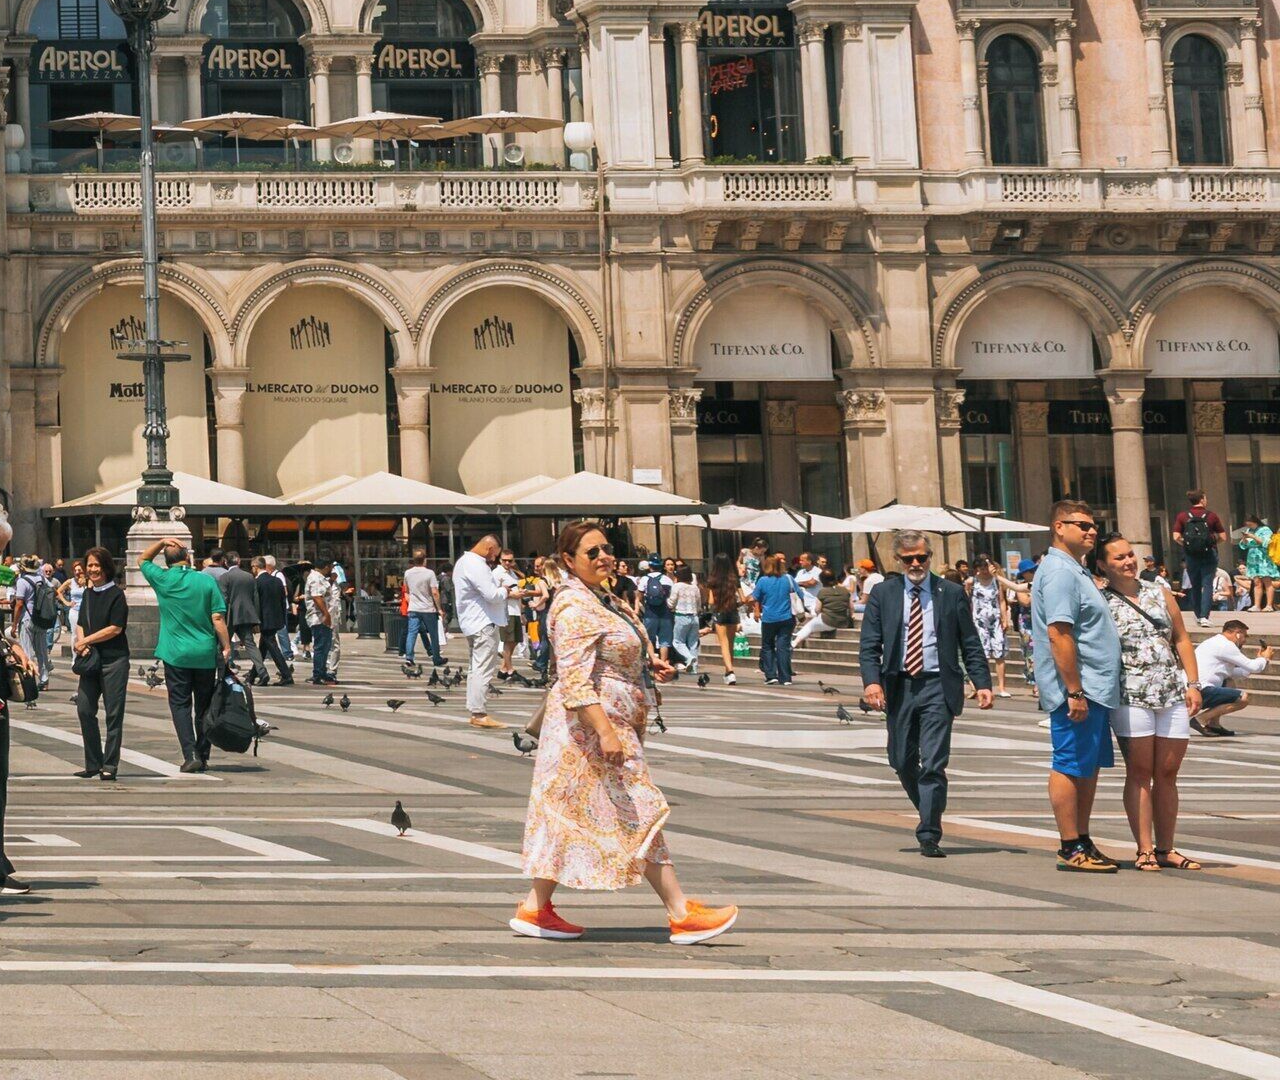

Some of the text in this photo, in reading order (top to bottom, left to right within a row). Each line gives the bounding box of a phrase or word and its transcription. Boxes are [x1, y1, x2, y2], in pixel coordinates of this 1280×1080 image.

[697, 10, 785, 37] APEROL
[699, 37, 786, 46] ERRAZZA
[38, 46, 122, 71] APEROL
[208, 45, 292, 70] APEROL
[378, 44, 462, 69] APEROL
[38, 71, 123, 80] TERRAZZA
[207, 70, 292, 78] TERRAZZA
[378, 69, 462, 78] TERRAZZA
[710, 343, 768, 356] TIFFANY
[972, 341, 1029, 354] TIFFANY
[1156, 339, 1214, 352] TIFFANY
[110, 382, 145, 398] Mott
[245, 382, 255, 393] IL
[257, 384, 313, 394] MERCATO
[331, 384, 379, 394] DUOMO
[430, 383, 440, 393] IL
[442, 384, 497, 394] MERCATO
[515, 383, 564, 394] DUOMO
